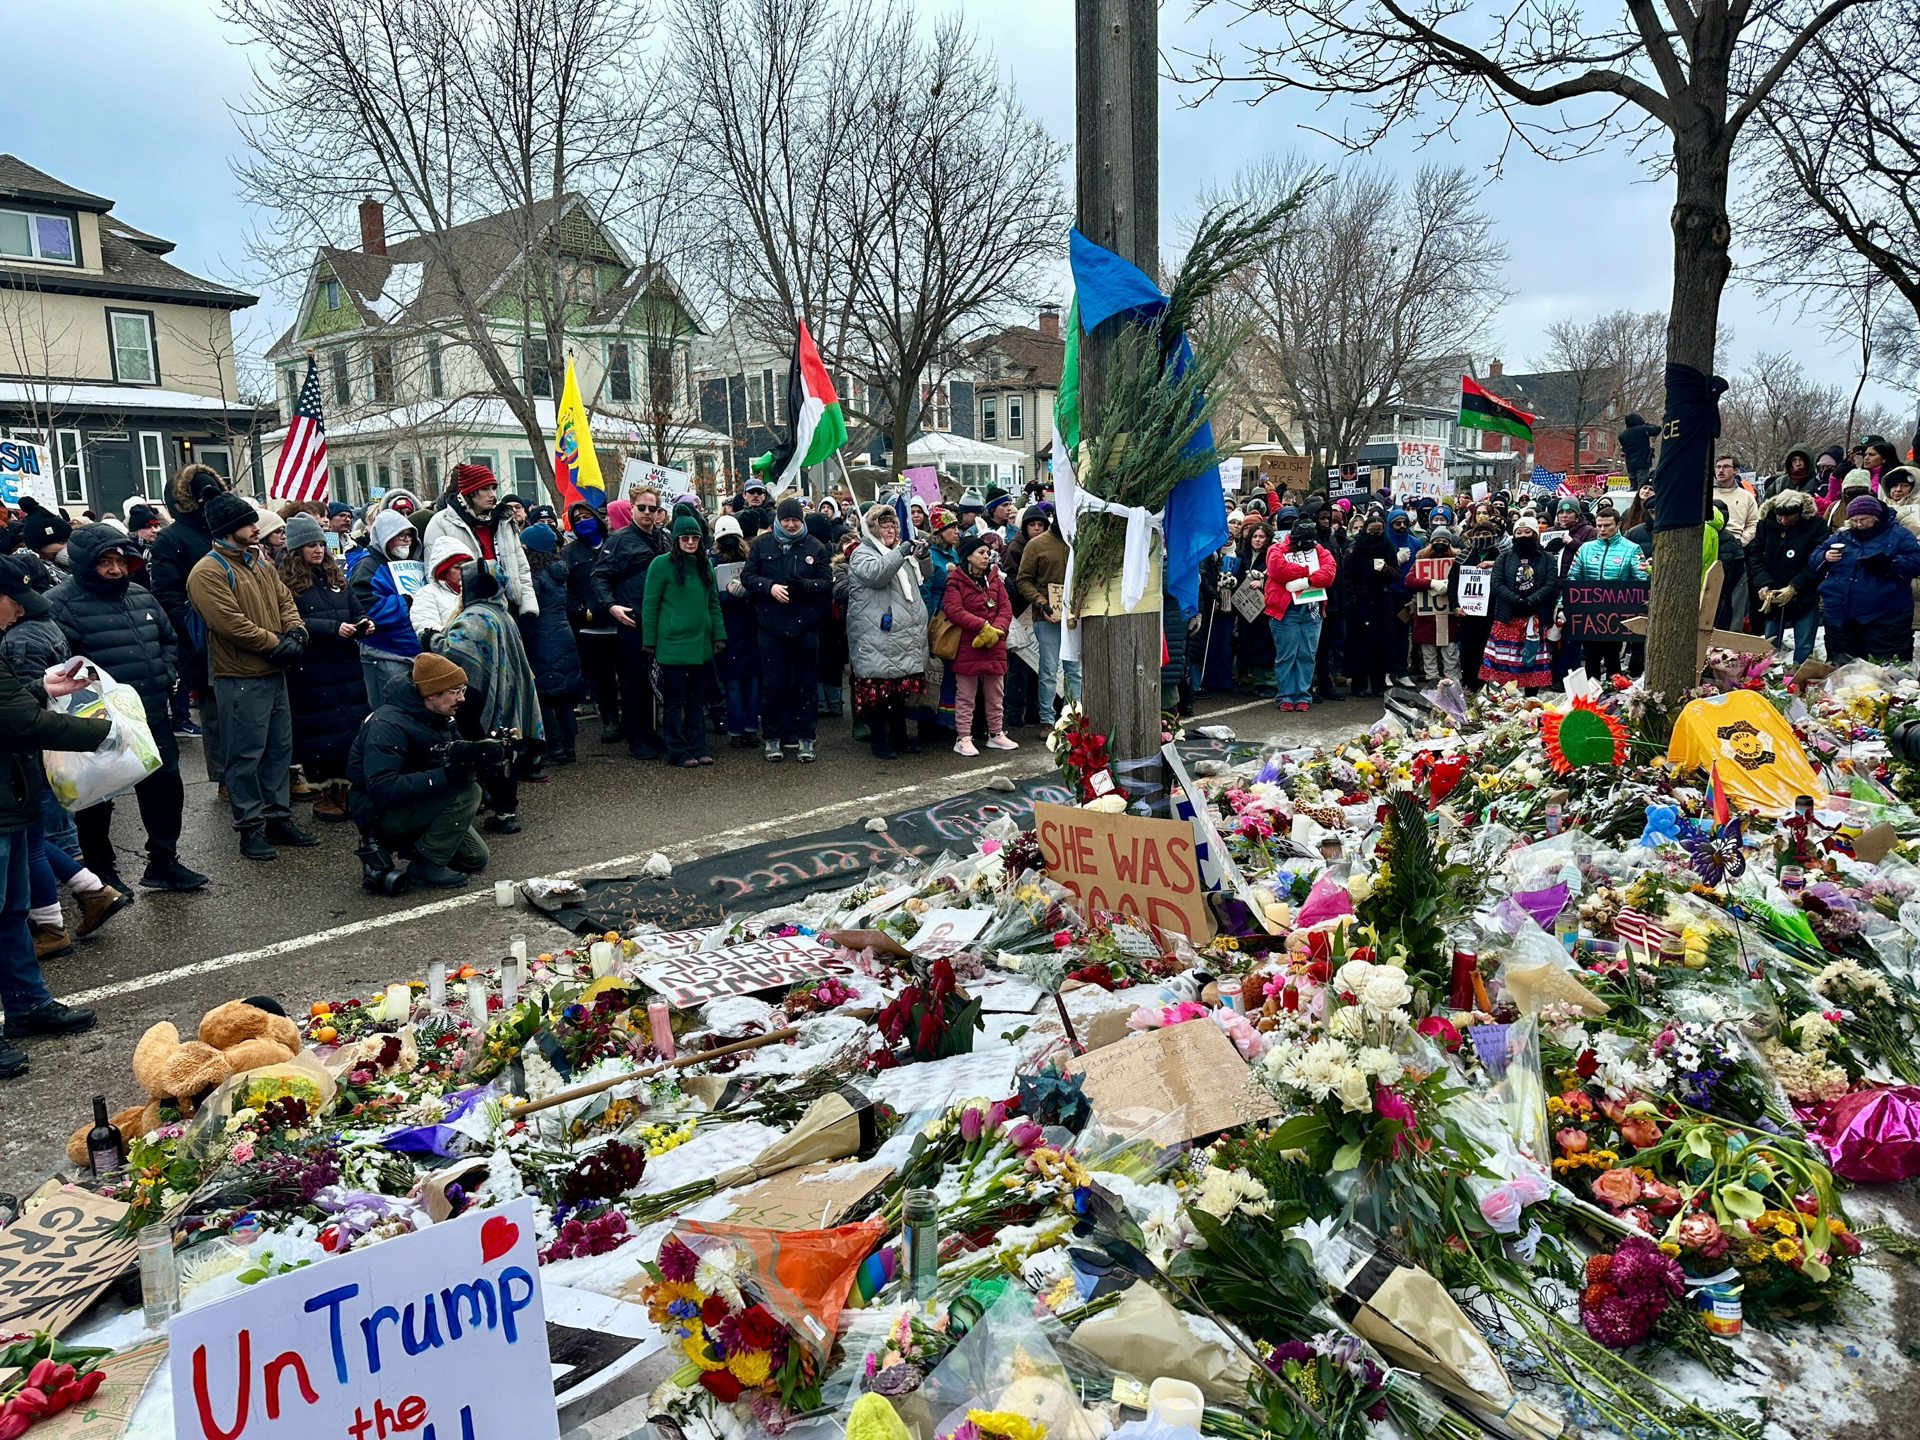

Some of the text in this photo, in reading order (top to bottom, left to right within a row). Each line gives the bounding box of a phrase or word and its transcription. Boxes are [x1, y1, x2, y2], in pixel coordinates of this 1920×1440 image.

[1401, 442, 1440, 456] HATE
[0, 442, 40, 475] SH
[1268, 460, 1303, 472] ABOLISH
[1399, 455, 1443, 470] DOES NOT
[651, 468, 666, 477] WE
[1272, 475, 1294, 484] ICE
[1397, 472, 1421, 480] MAKE
[0, 474, 20, 504] E
[648, 481, 664, 490] OUR
[1330, 488, 1367, 497] RESISTANCE
[1399, 481, 1441, 496] AMERICA
[1287, 552, 1312, 564] FREE
[1418, 559, 1454, 580] FUC
[1470, 575, 1481, 583] FOR
[1464, 583, 1484, 596] ALL
[1569, 587, 1651, 604] DISMANTL
[1419, 591, 1448, 612] IC
[1571, 612, 1645, 635] FASCI
[1733, 732, 1750, 742] UNITY
[1735, 743, 1762, 758] COMMUNITY
[1041, 820, 1098, 875] SHE
[1107, 833, 1195, 894] WAS
[659, 948, 836, 987] GEZAHEGN
[675, 959, 854, 1005] SERAWIT
[348, 1395, 430, 1440] the
